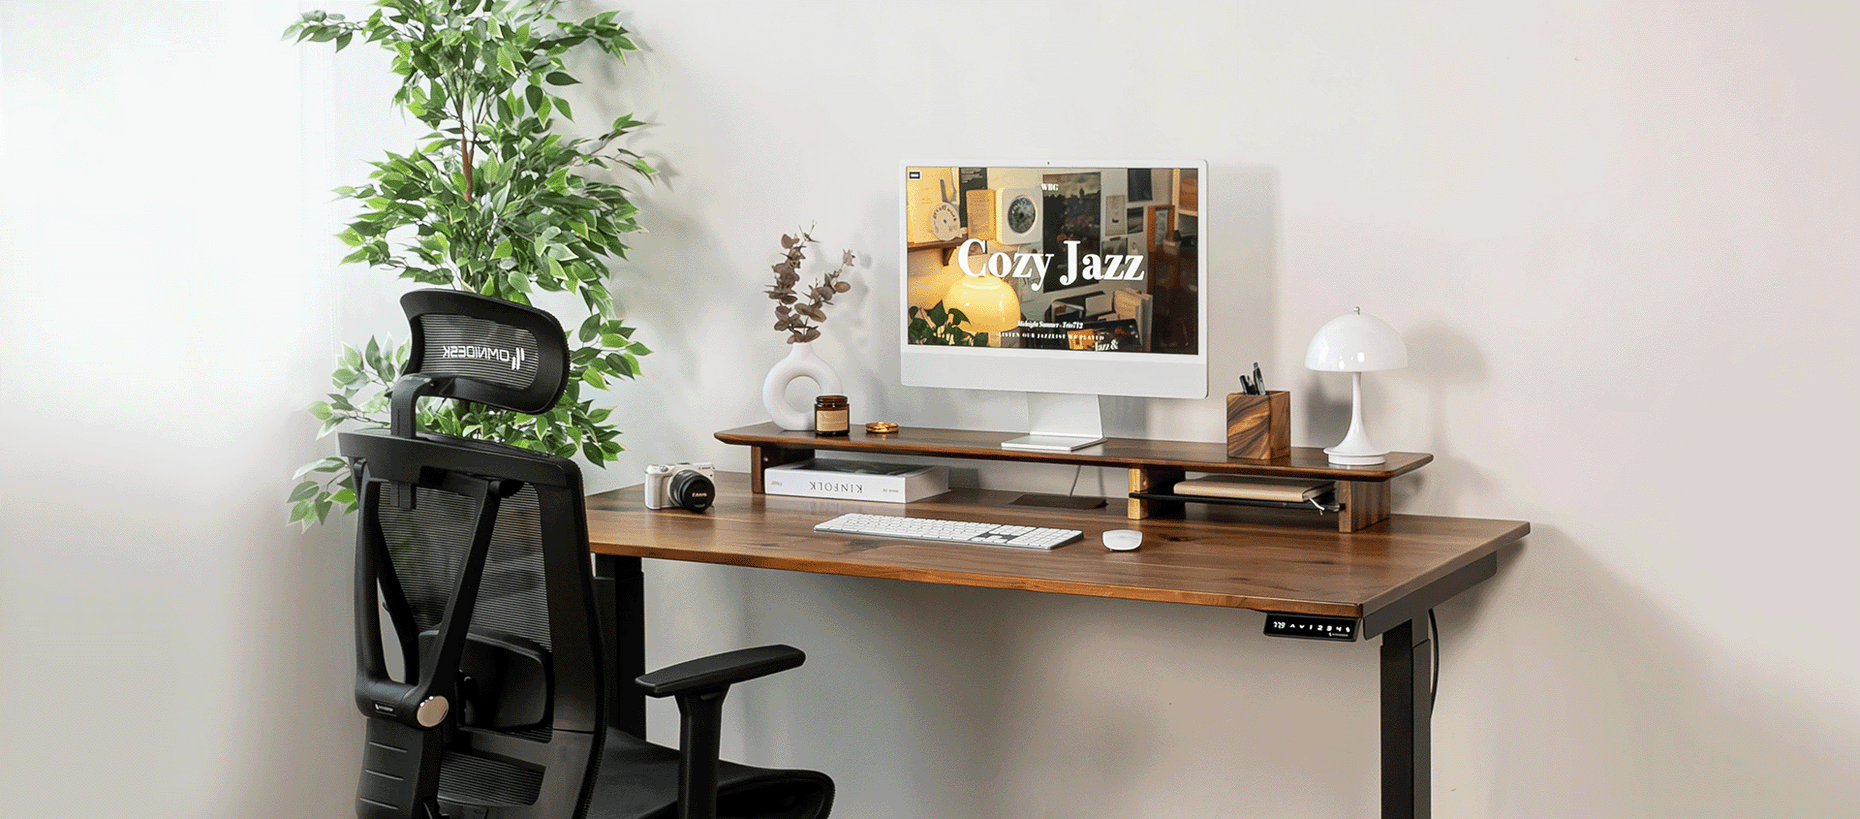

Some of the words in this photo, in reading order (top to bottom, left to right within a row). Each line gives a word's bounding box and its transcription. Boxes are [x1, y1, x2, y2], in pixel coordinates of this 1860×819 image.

[957, 238, 1054, 291] Cozy
[1059, 240, 1145, 286] Jazz
[809, 481, 863, 494] KINFOLK
